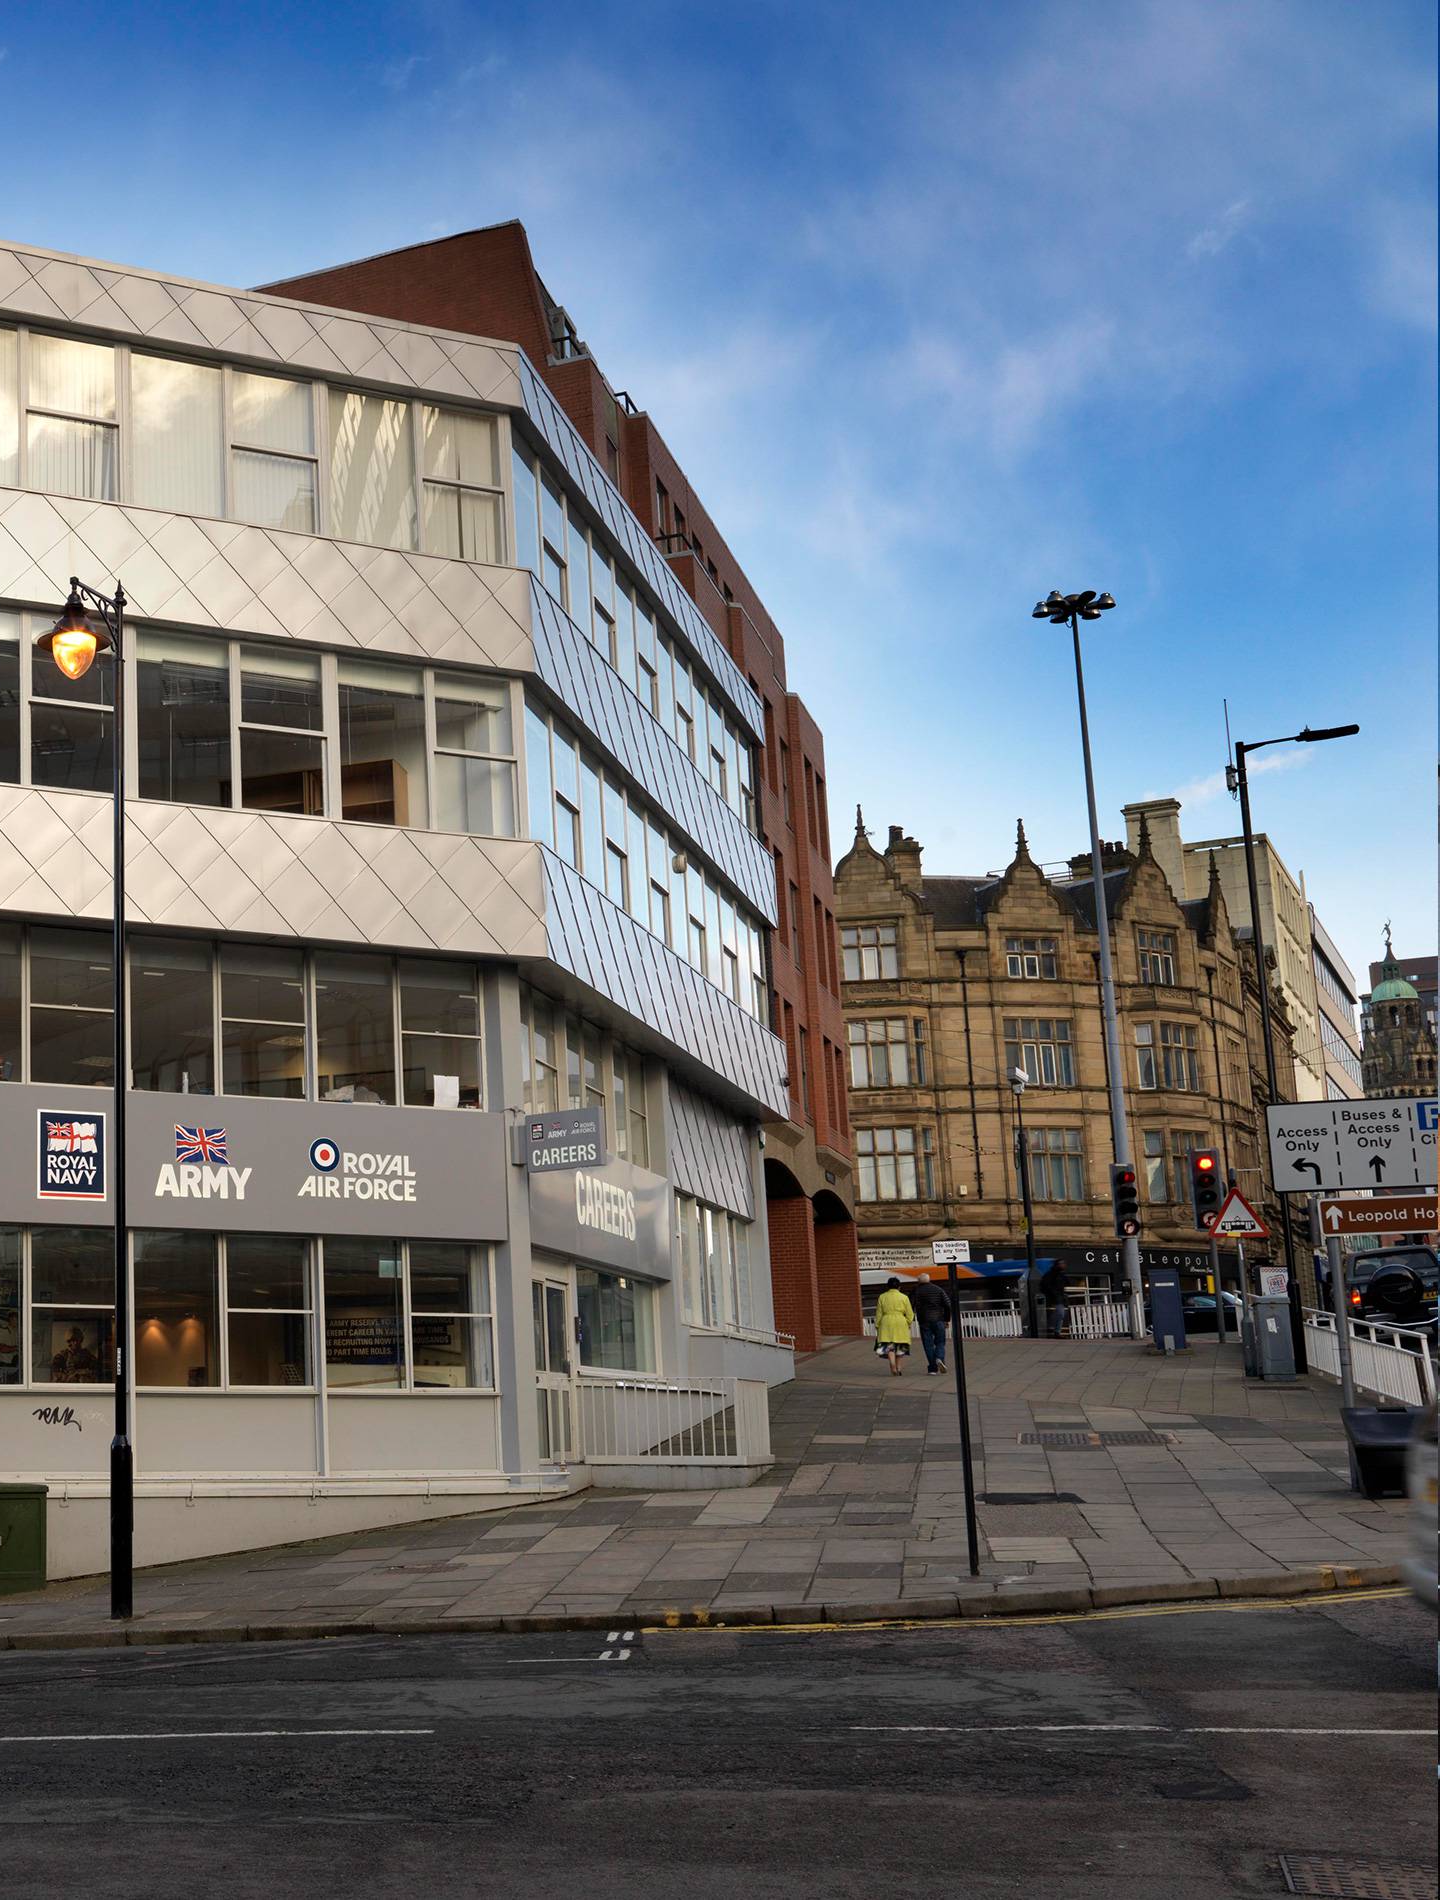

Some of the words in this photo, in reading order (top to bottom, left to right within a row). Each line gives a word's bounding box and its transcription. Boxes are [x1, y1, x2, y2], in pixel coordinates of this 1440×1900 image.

[1341, 1110, 1386, 1121] Buses
[1392, 1108, 1402, 1119] &
[548, 1129, 567, 1139] ARMY
[1276, 1127, 1328, 1138] Access
[1347, 1123, 1400, 1135] Access
[1285, 1139, 1320, 1152] Only
[1357, 1136, 1392, 1149] Only
[1420, 1134, 1438, 1145] Ci
[532, 1143, 597, 1166] CAREERS
[47, 1154, 97, 1170] ROYAL
[343, 1152, 416, 1178] ROYAL
[47, 1168, 97, 1186] NAVY
[155, 1164, 252, 1200] ARMY
[297, 1176, 340, 1198] AIR
[343, 1178, 417, 1202] FORCE
[575, 1170, 636, 1241] CAREERS
[1348, 1208, 1408, 1223] Leopold
[1414, 1208, 1438, 1220] Ho
[1150, 1255, 1209, 1266] Leopol
[350, 1319, 380, 1327] RESERVE
[349, 1328, 374, 1336] CAREER
[376, 1328, 384, 1336] IN
[334, 1338, 373, 1346] RECRUITING
[334, 1348, 351, 1356] PART
